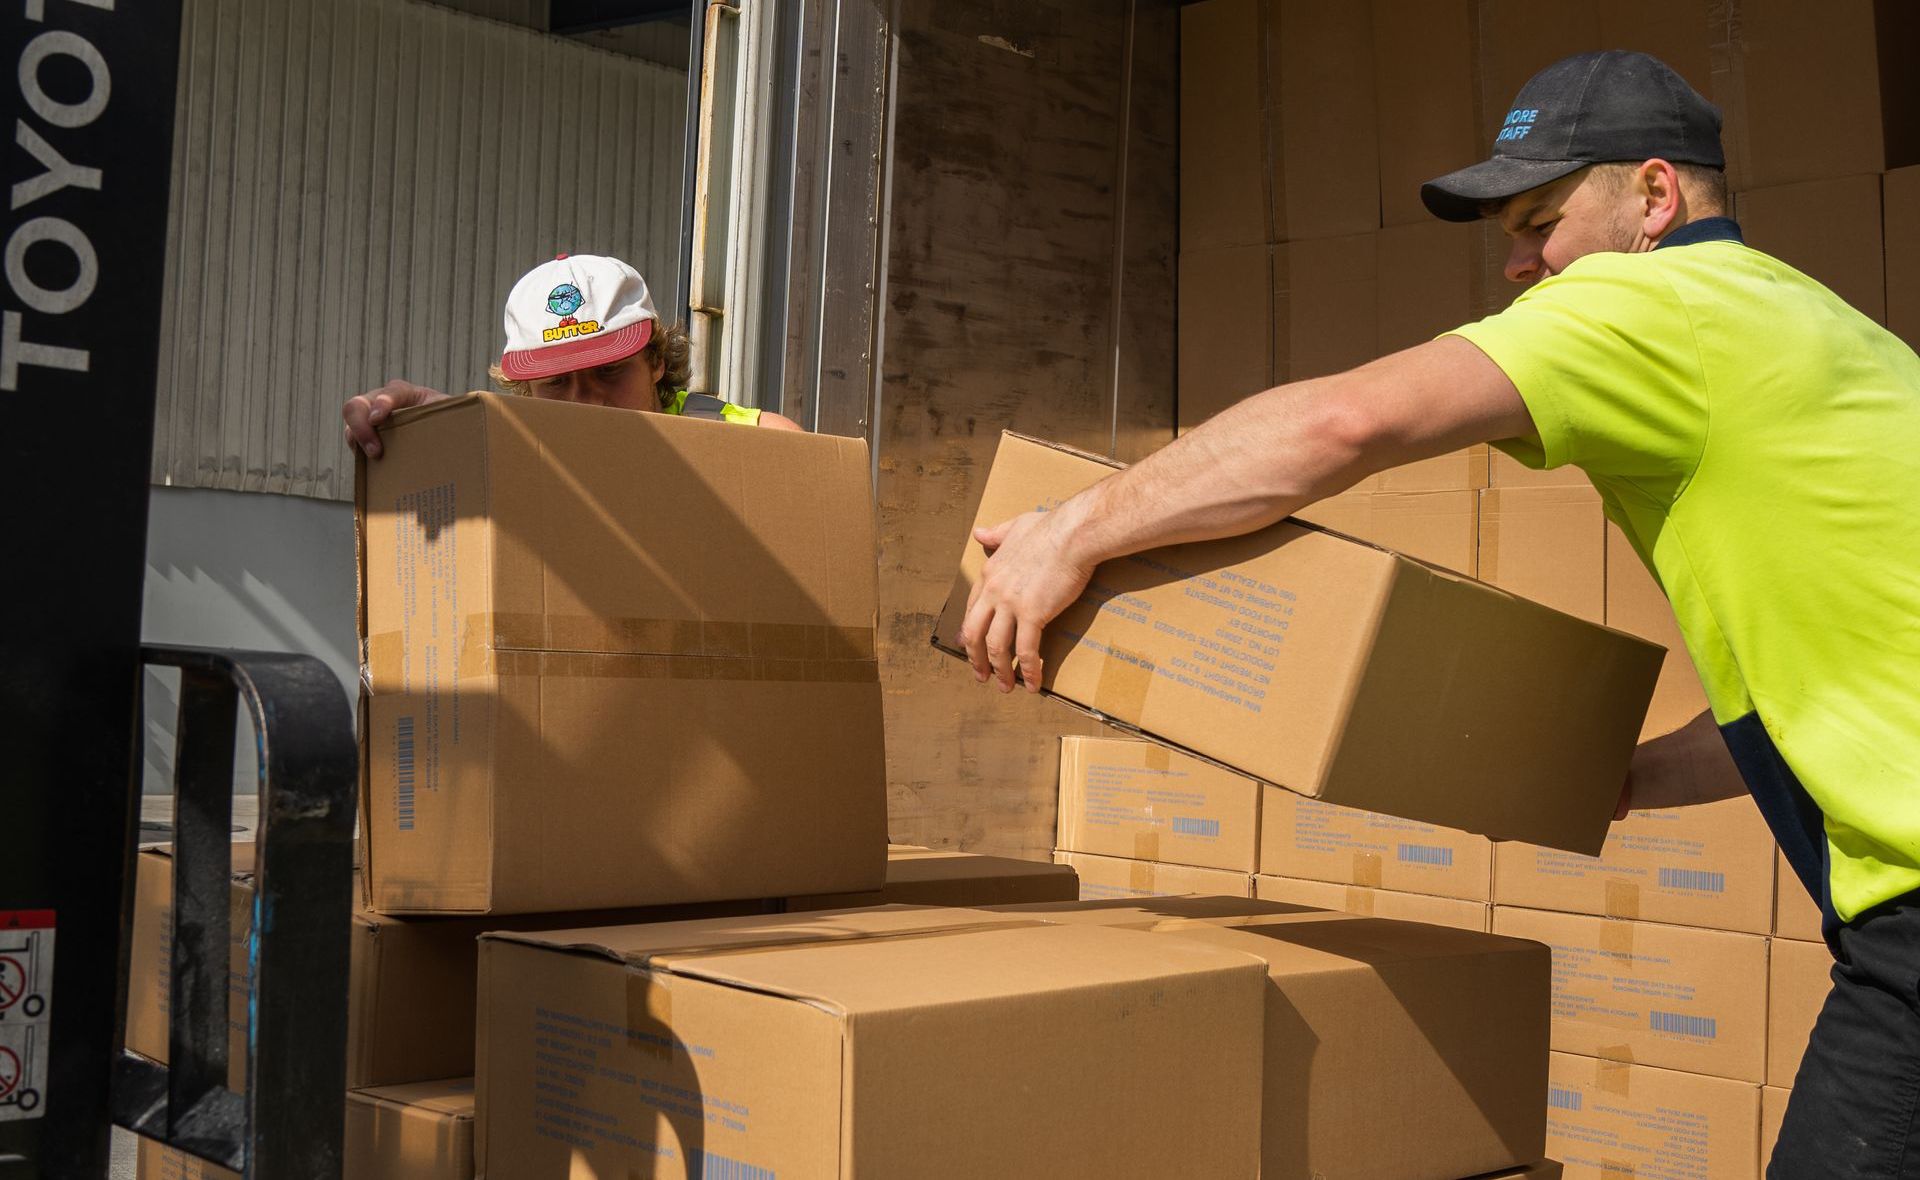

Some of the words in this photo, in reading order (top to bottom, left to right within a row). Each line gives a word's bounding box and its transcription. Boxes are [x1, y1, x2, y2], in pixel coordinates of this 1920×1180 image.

[0, 0, 114, 391] TOYO
[542, 320, 600, 342] BUTTER
[1111, 647, 1138, 665] WHITE
[1139, 658, 1155, 671] AND
